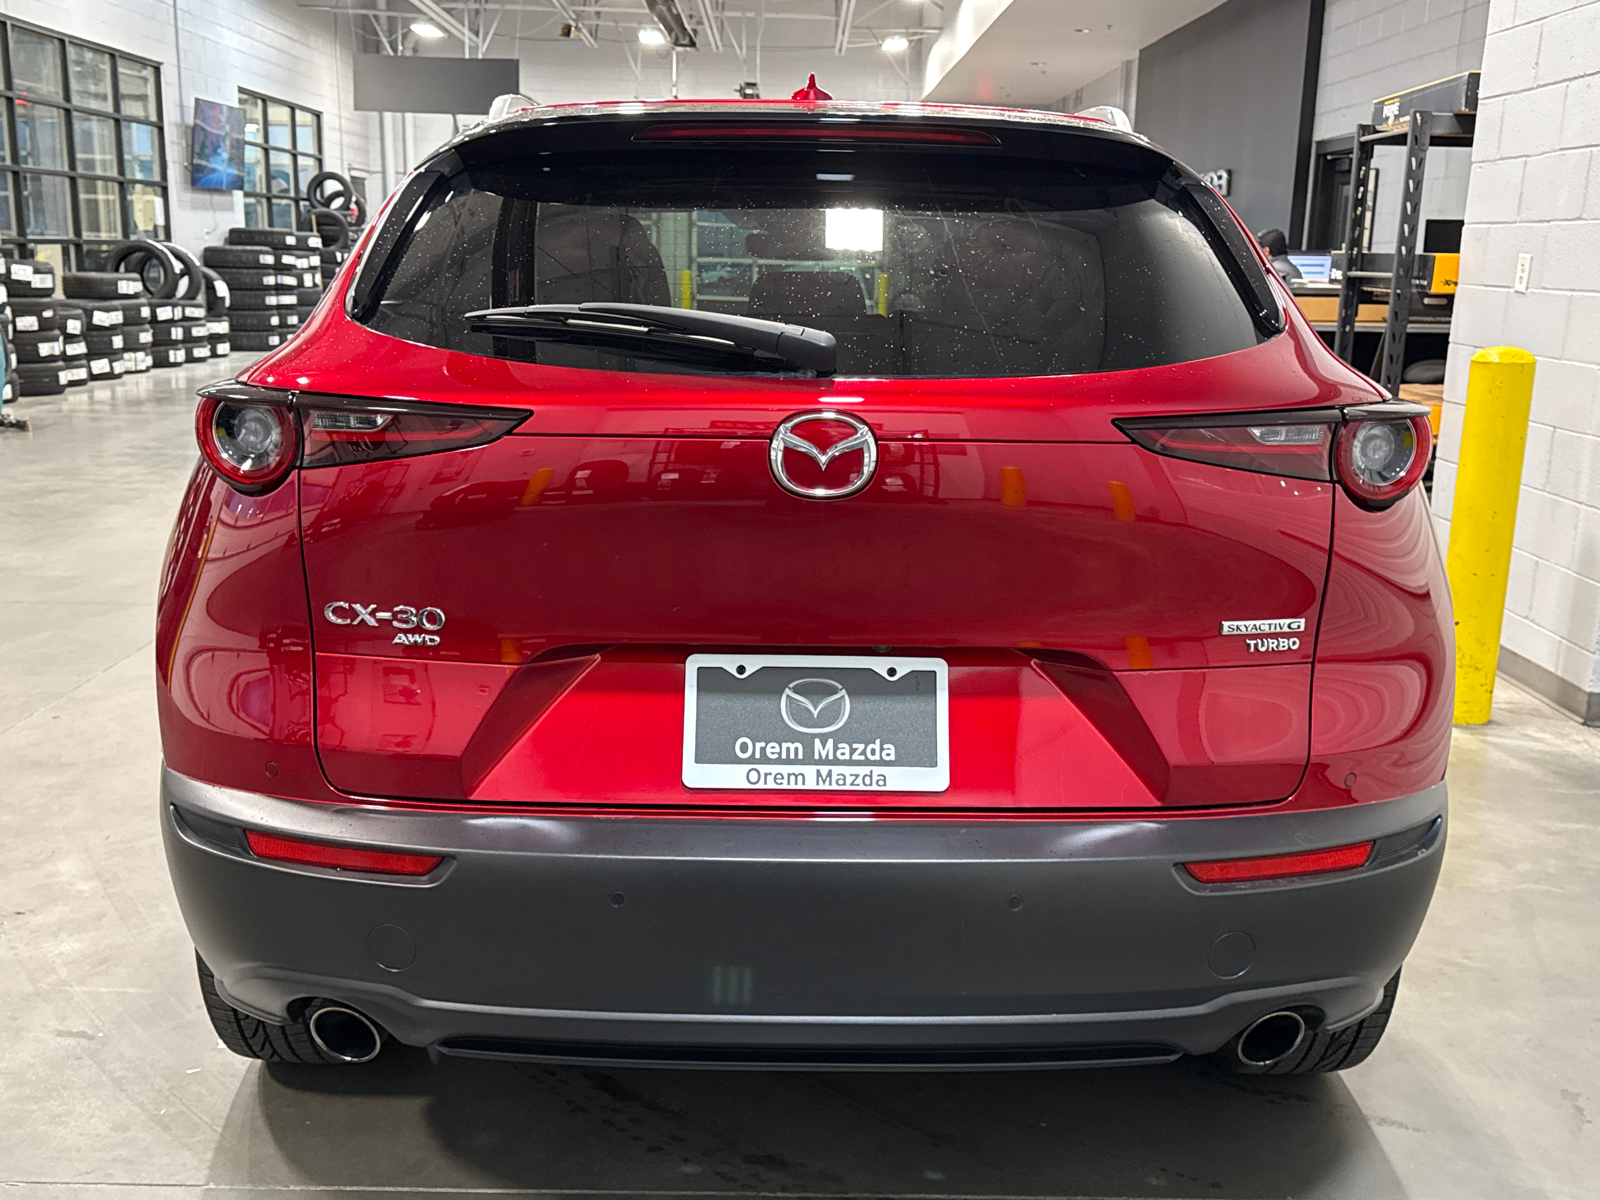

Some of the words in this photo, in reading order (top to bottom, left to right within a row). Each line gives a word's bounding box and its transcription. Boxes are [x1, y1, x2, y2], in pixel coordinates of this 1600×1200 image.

[323, 601, 446, 631] CX-30
[392, 633, 441, 646] AWD
[1245, 637, 1300, 653] TURBO
[735, 737, 803, 759] Orem
[814, 738, 896, 761] Mazda
[746, 768, 806, 786] Orem
[815, 769, 887, 787] Mazda
